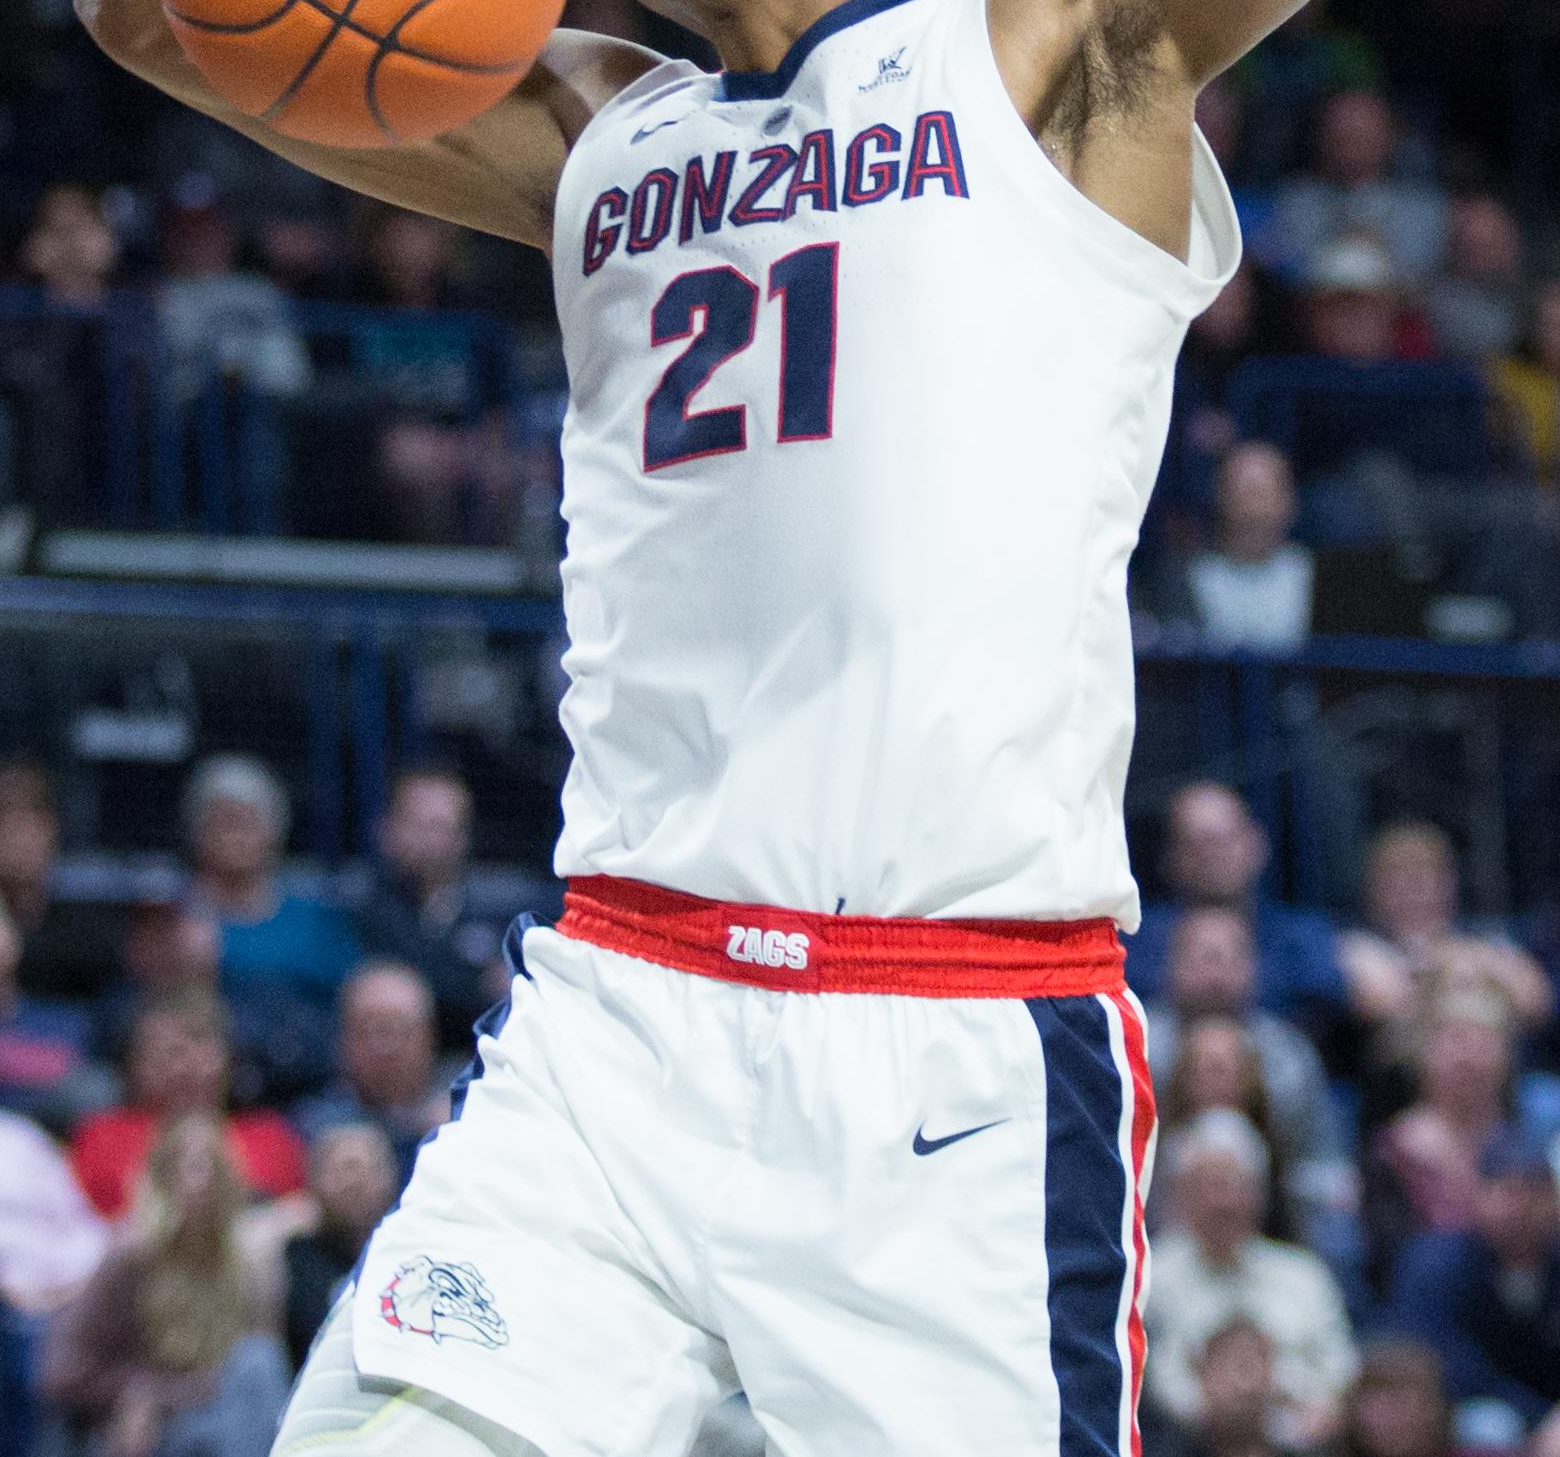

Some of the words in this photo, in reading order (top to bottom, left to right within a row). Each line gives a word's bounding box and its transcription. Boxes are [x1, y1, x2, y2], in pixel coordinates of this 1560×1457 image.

[583, 110, 970, 277] GONZAGA
[643, 241, 839, 473] 21
[726, 925, 810, 970] ZAGS
